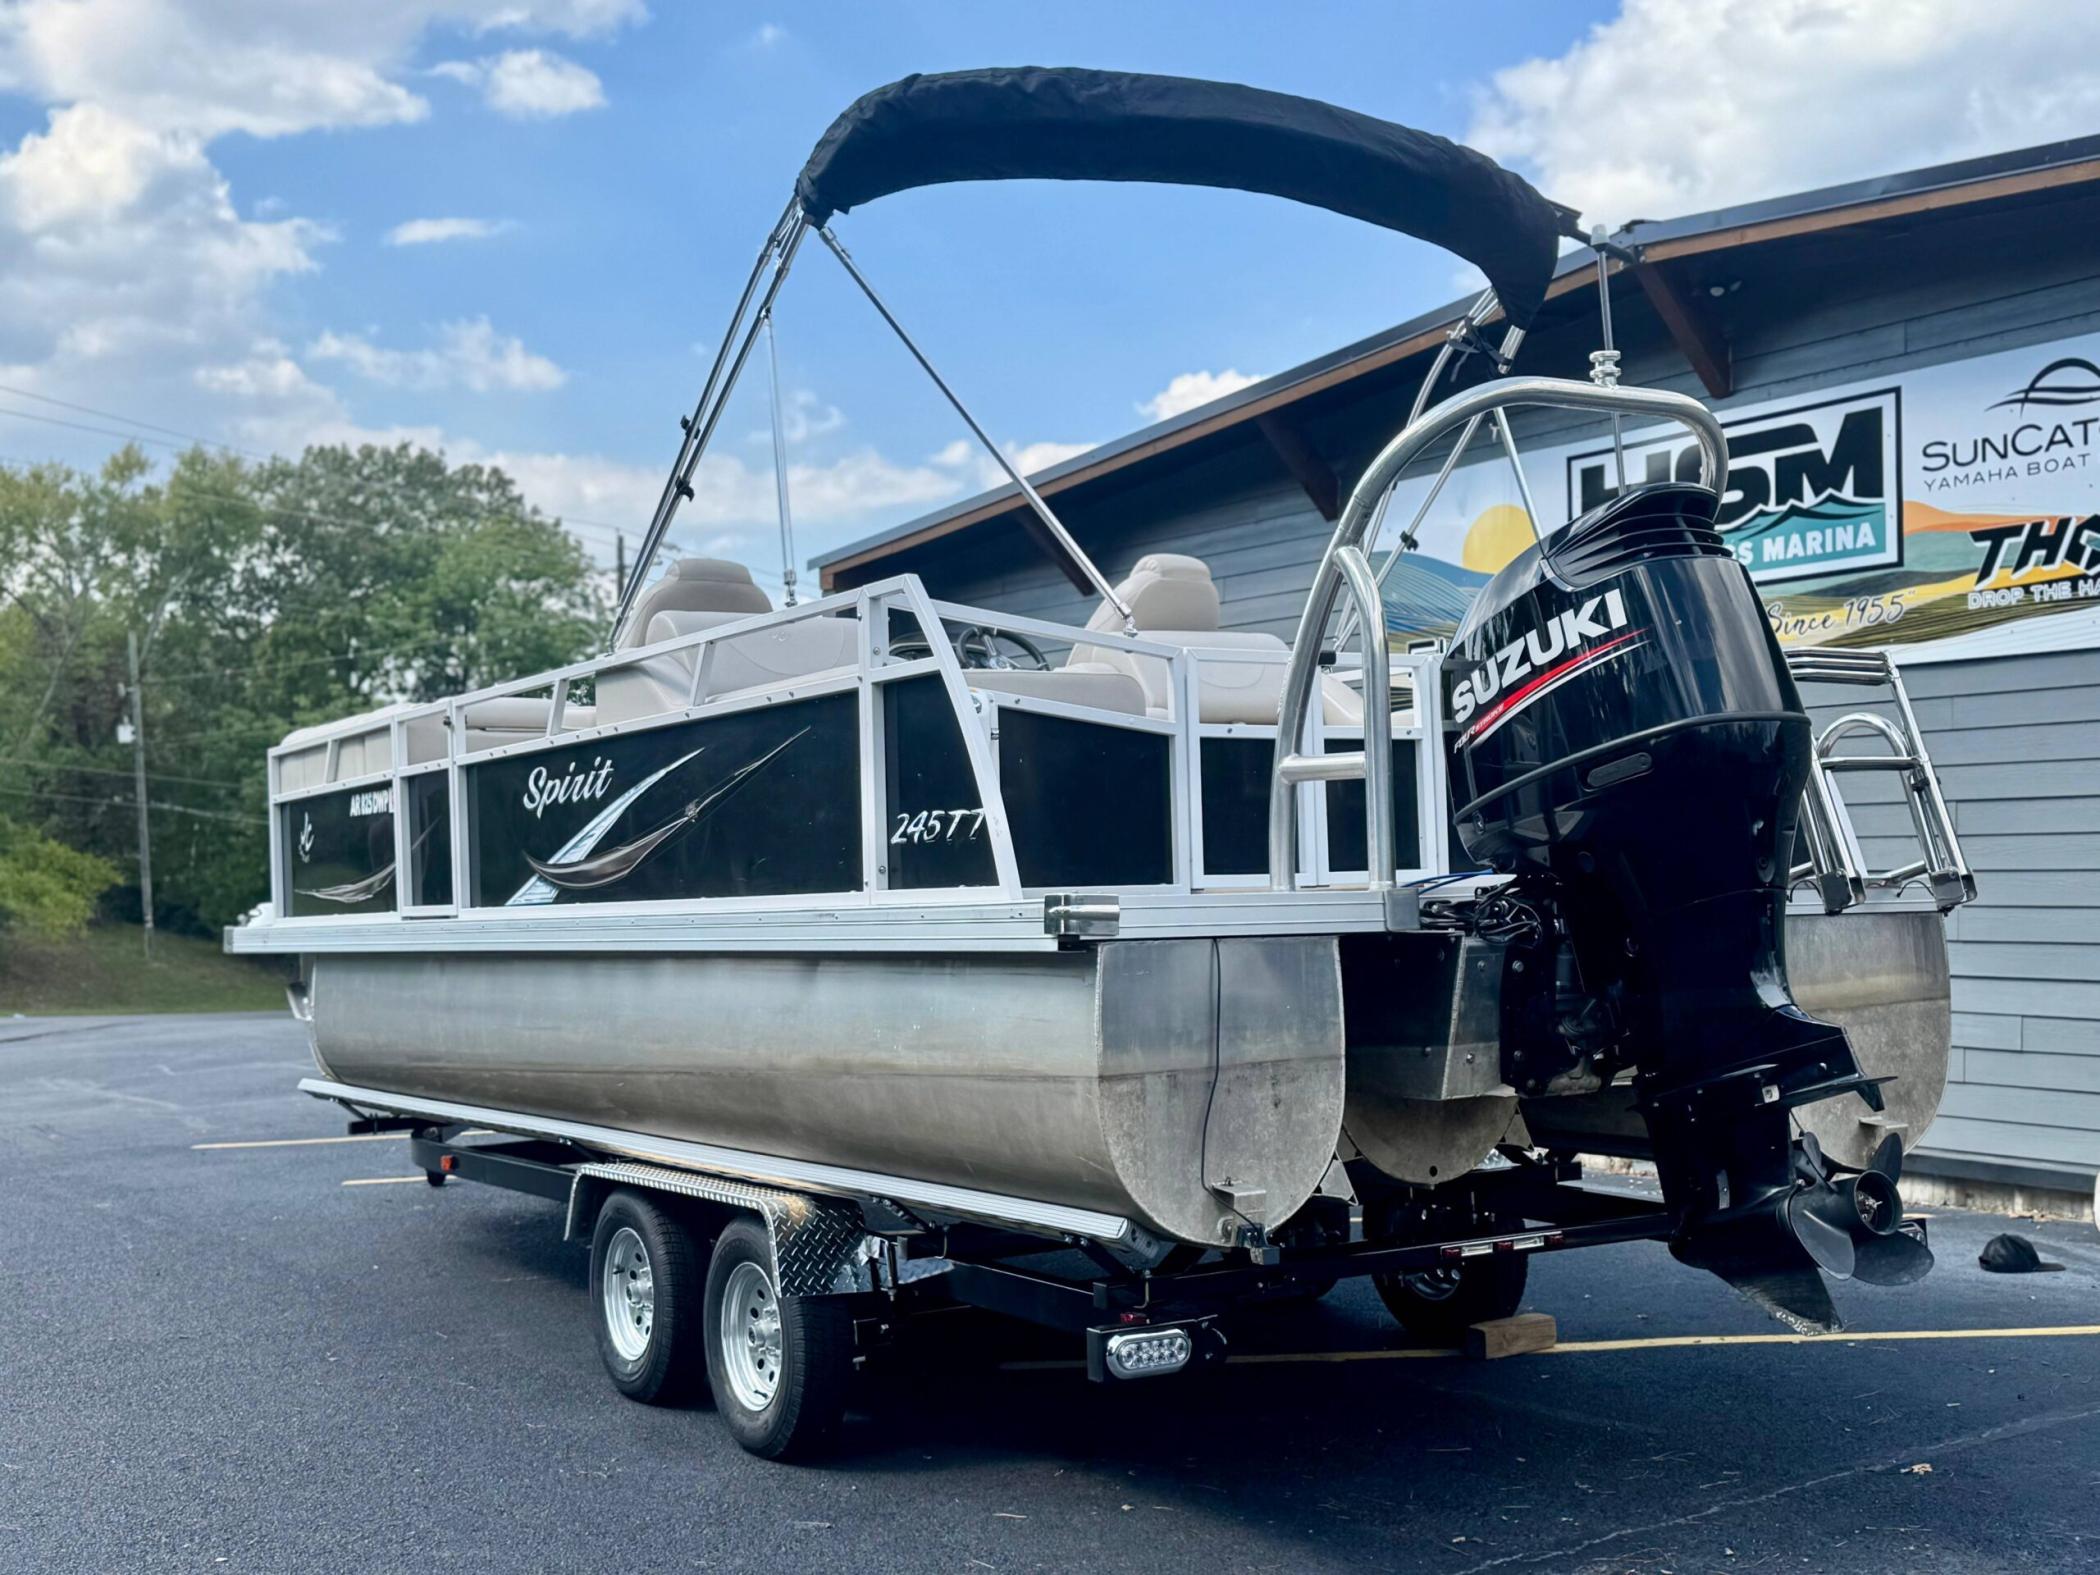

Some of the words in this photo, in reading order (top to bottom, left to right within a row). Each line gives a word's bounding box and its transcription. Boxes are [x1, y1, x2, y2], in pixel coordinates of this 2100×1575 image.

[1922, 417, 2100, 472] SUNCAT
[1924, 466, 2018, 492] YAMAHA
[2027, 453, 2091, 477] BOAT
[1763, 522, 1876, 563] MARINA
[1968, 587, 2024, 610] DROP
[2030, 581, 2072, 603] THE
[1768, 603, 1834, 636] Since
[1452, 588, 1628, 724] SUZUKI
[523, 756, 614, 819] Spirit
